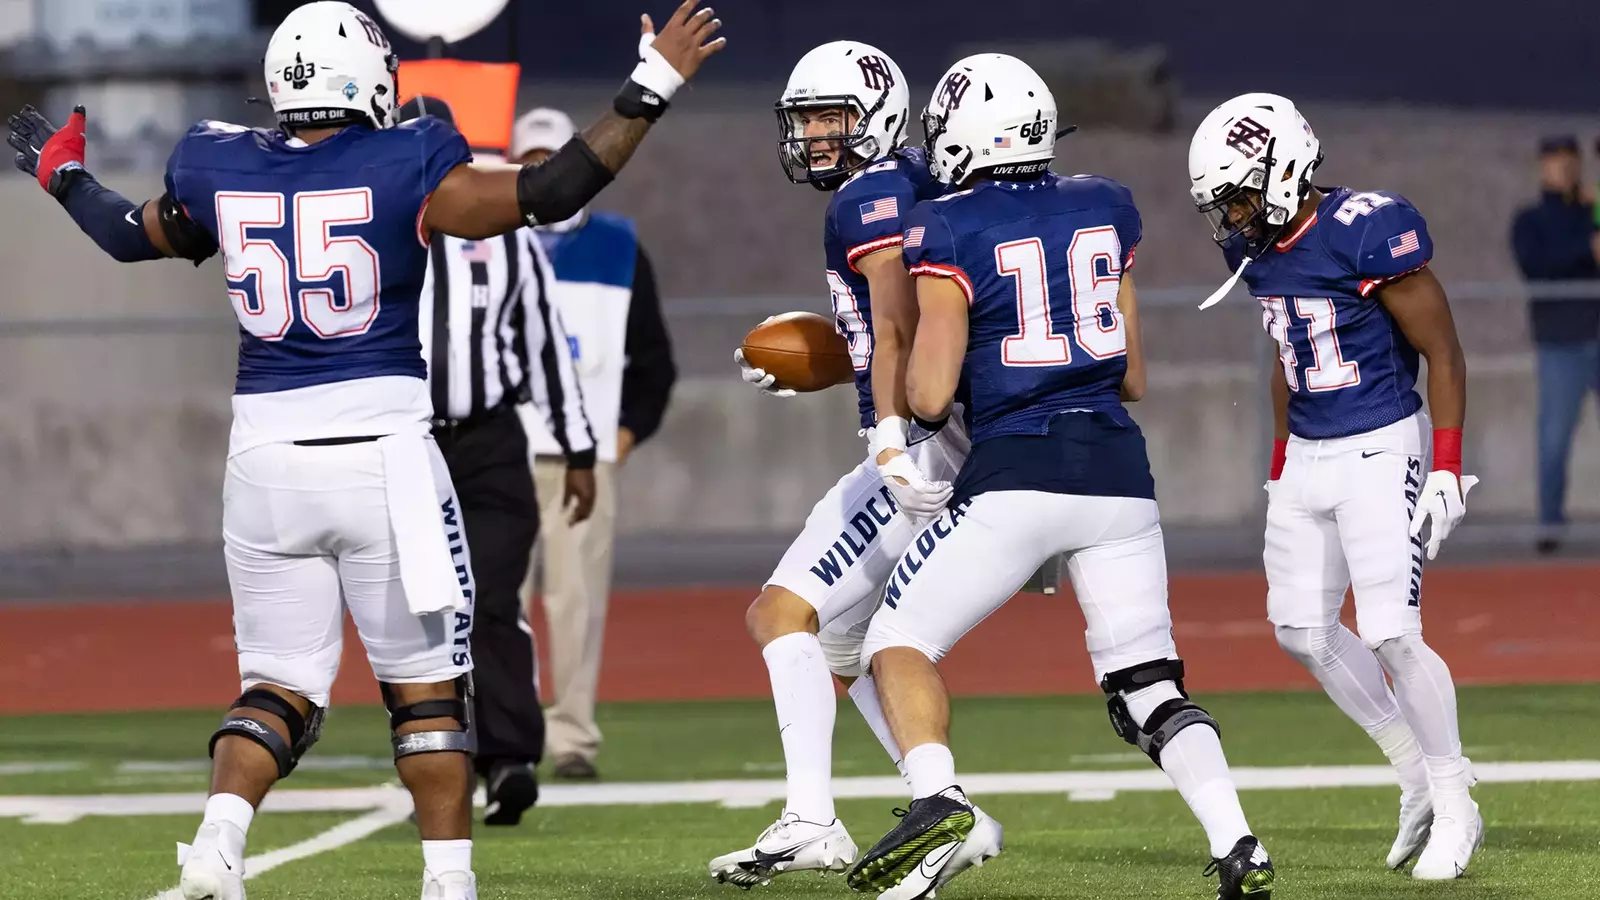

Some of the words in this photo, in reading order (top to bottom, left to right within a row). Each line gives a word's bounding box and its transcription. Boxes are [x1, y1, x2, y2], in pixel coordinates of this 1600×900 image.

[283, 62, 316, 82] 603
[289, 112, 310, 122] FREE
[312, 110, 327, 120] OR
[329, 109, 346, 119] DIE
[1019, 119, 1048, 138] 603
[992, 166, 1015, 175] LIVE
[1015, 163, 1038, 174] FREE
[1332, 192, 1394, 226] 41
[215, 187, 381, 341] 55
[994, 225, 1127, 367] 16
[1257, 296, 1360, 392] 41
[885, 497, 974, 610] WILDCA
